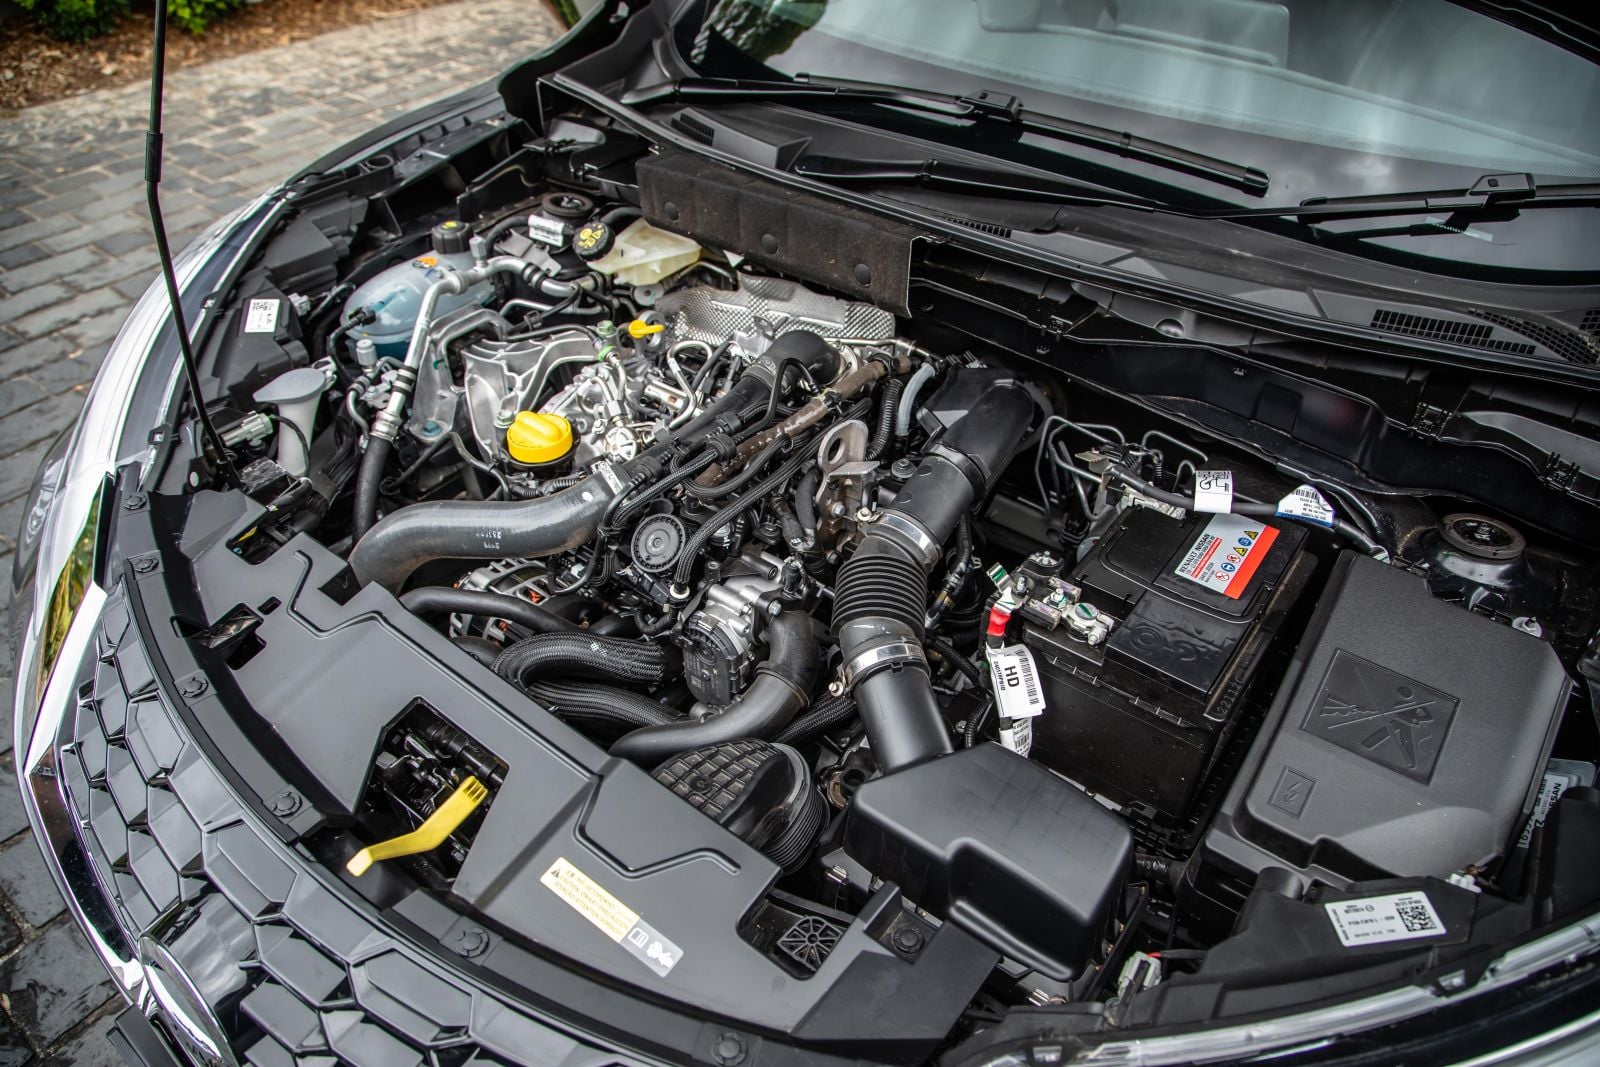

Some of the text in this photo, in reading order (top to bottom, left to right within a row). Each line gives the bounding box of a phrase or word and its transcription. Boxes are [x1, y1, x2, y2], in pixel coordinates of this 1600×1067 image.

[1180, 551, 1197, 573] RENAULT
[1195, 533, 1210, 551] NISSAN
[1004, 665, 1020, 688] HD
